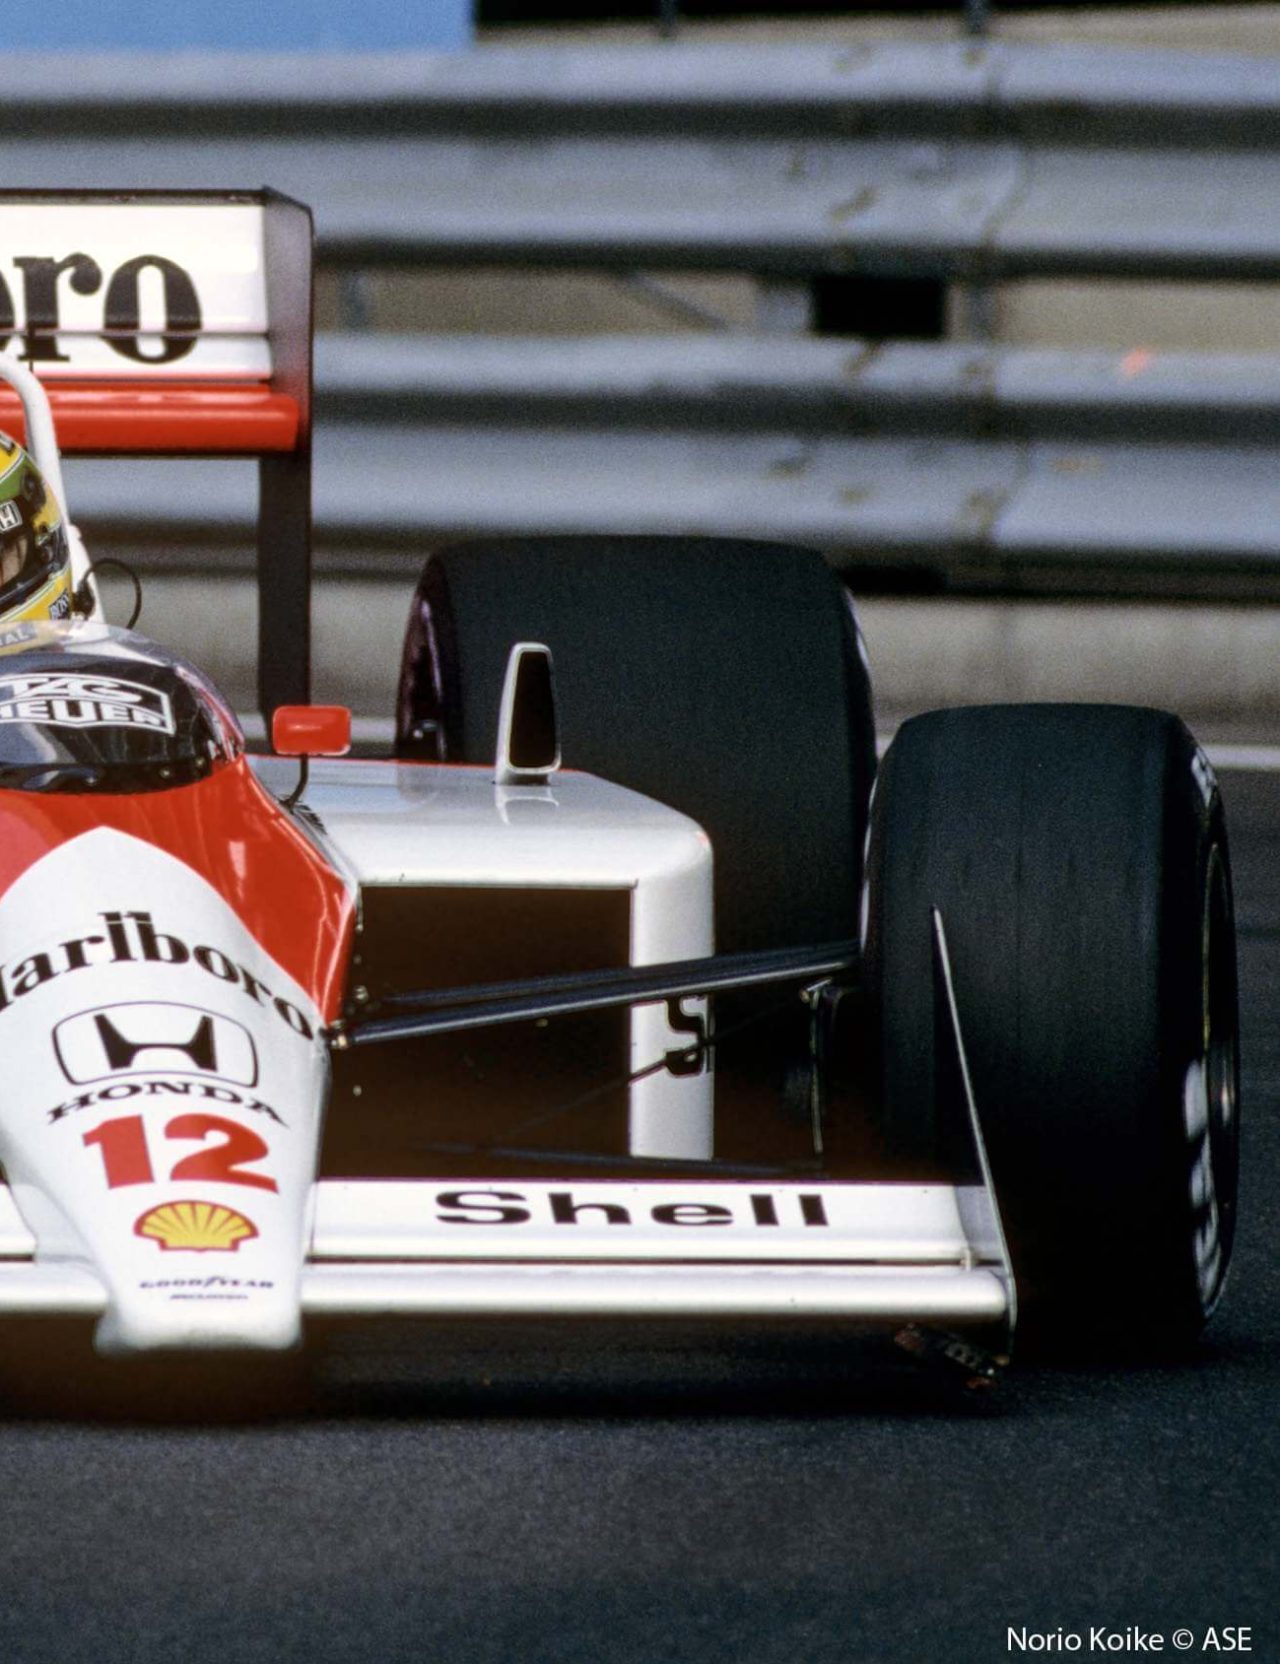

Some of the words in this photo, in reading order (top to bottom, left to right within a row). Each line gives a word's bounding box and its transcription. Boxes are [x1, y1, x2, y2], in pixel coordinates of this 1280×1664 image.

[47, 1081, 292, 1129] HONDA
[82, 1112, 280, 1195] 12
[435, 1190, 830, 1227] Shell
